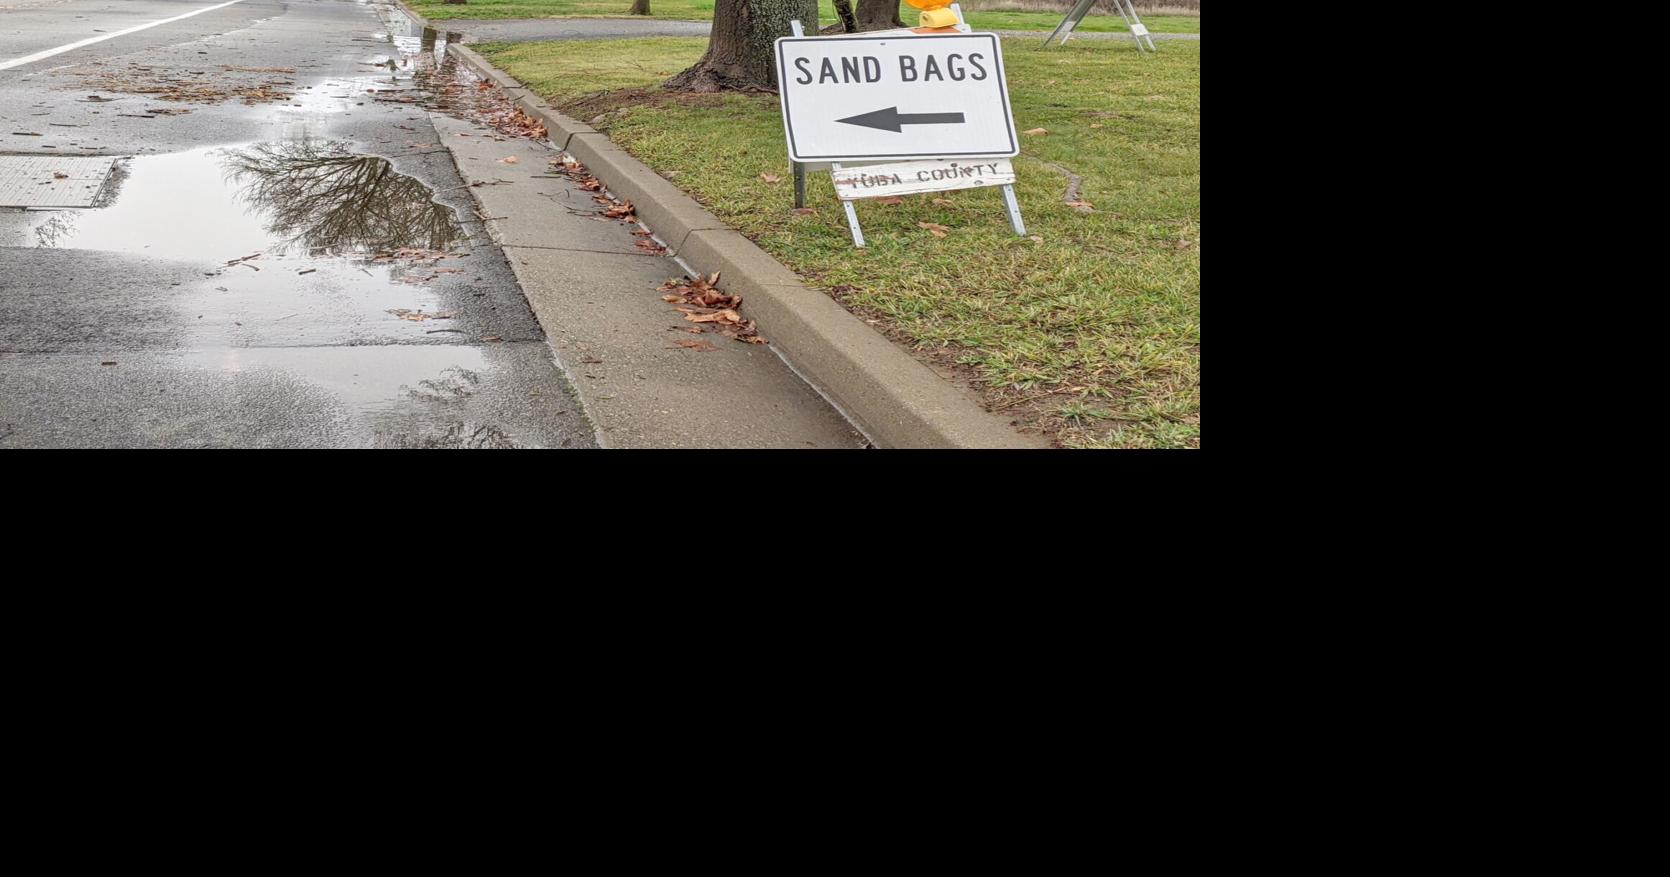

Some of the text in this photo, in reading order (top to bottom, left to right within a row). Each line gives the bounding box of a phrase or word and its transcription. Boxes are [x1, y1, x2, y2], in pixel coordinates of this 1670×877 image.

[795, 52, 988, 85] SAND BAGS
[848, 163, 998, 189] YUBA COUNTY
